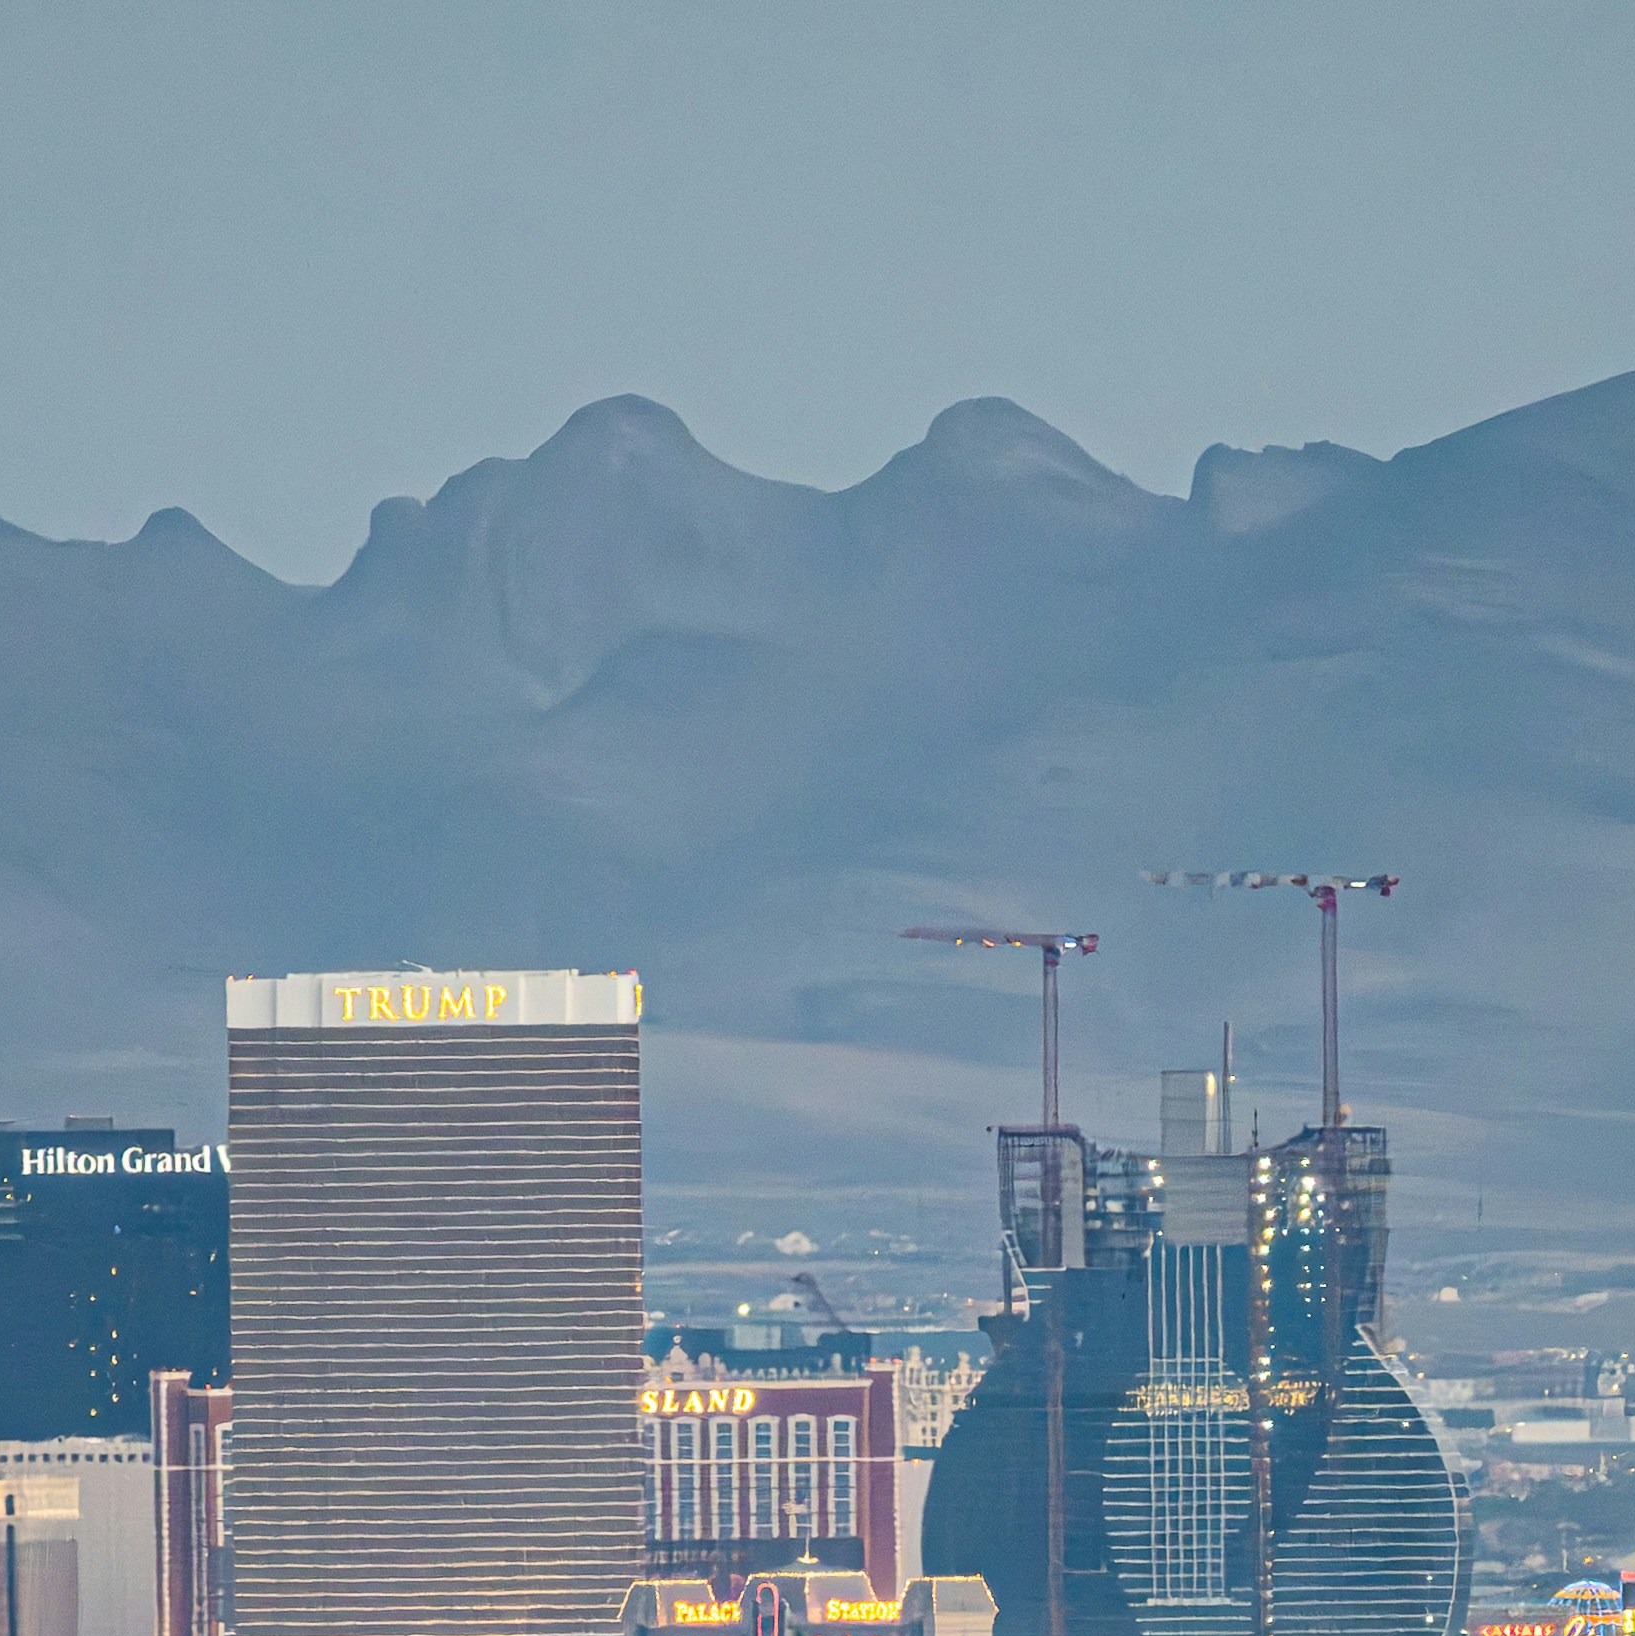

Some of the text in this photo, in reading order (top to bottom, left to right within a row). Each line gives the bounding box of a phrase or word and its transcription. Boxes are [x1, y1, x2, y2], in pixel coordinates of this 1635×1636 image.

[334, 985, 508, 1021] TRUMP
[21, 1147, 115, 1175] Hilton
[122, 1145, 211, 1173] Grand
